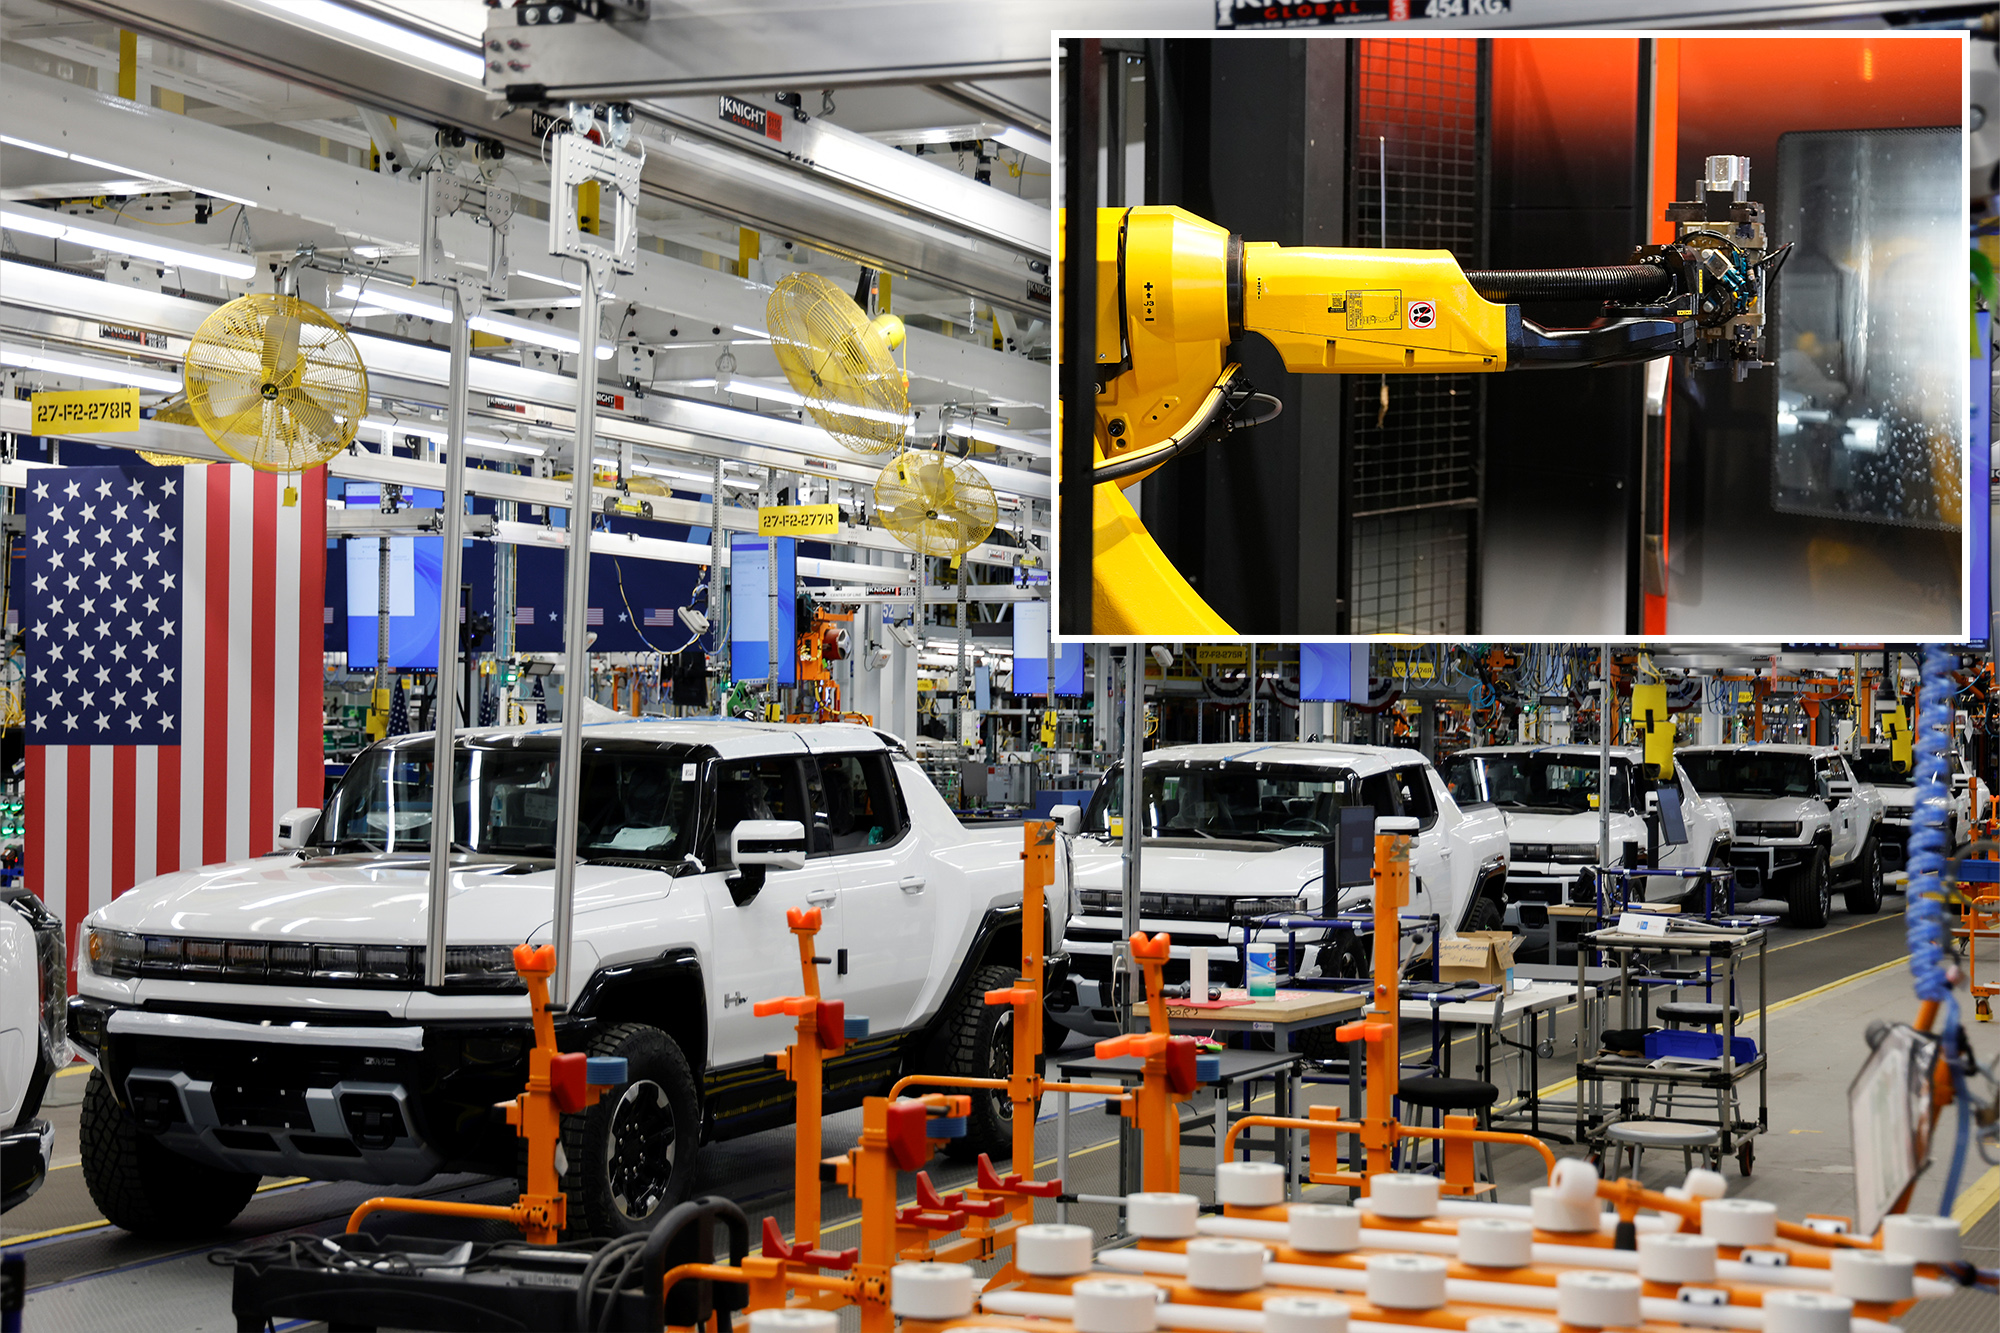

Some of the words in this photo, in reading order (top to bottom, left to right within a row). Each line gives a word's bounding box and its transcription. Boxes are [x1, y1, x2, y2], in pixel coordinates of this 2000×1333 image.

[1264, 1, 1360, 19] GLOBAL
[1424, 0, 1464, 18] 454
[725, 97, 766, 125] KNIGHT
[732, 114, 758, 130] GLOBAL
[37, 402, 132, 422] 27-F2-278R
[763, 513, 834, 528] 27-F2-277R
[882, 603, 894, 618] 52
[1199, 650, 1243, 659] 27-F2-275R
[364, 1056, 396, 1066] GMC
